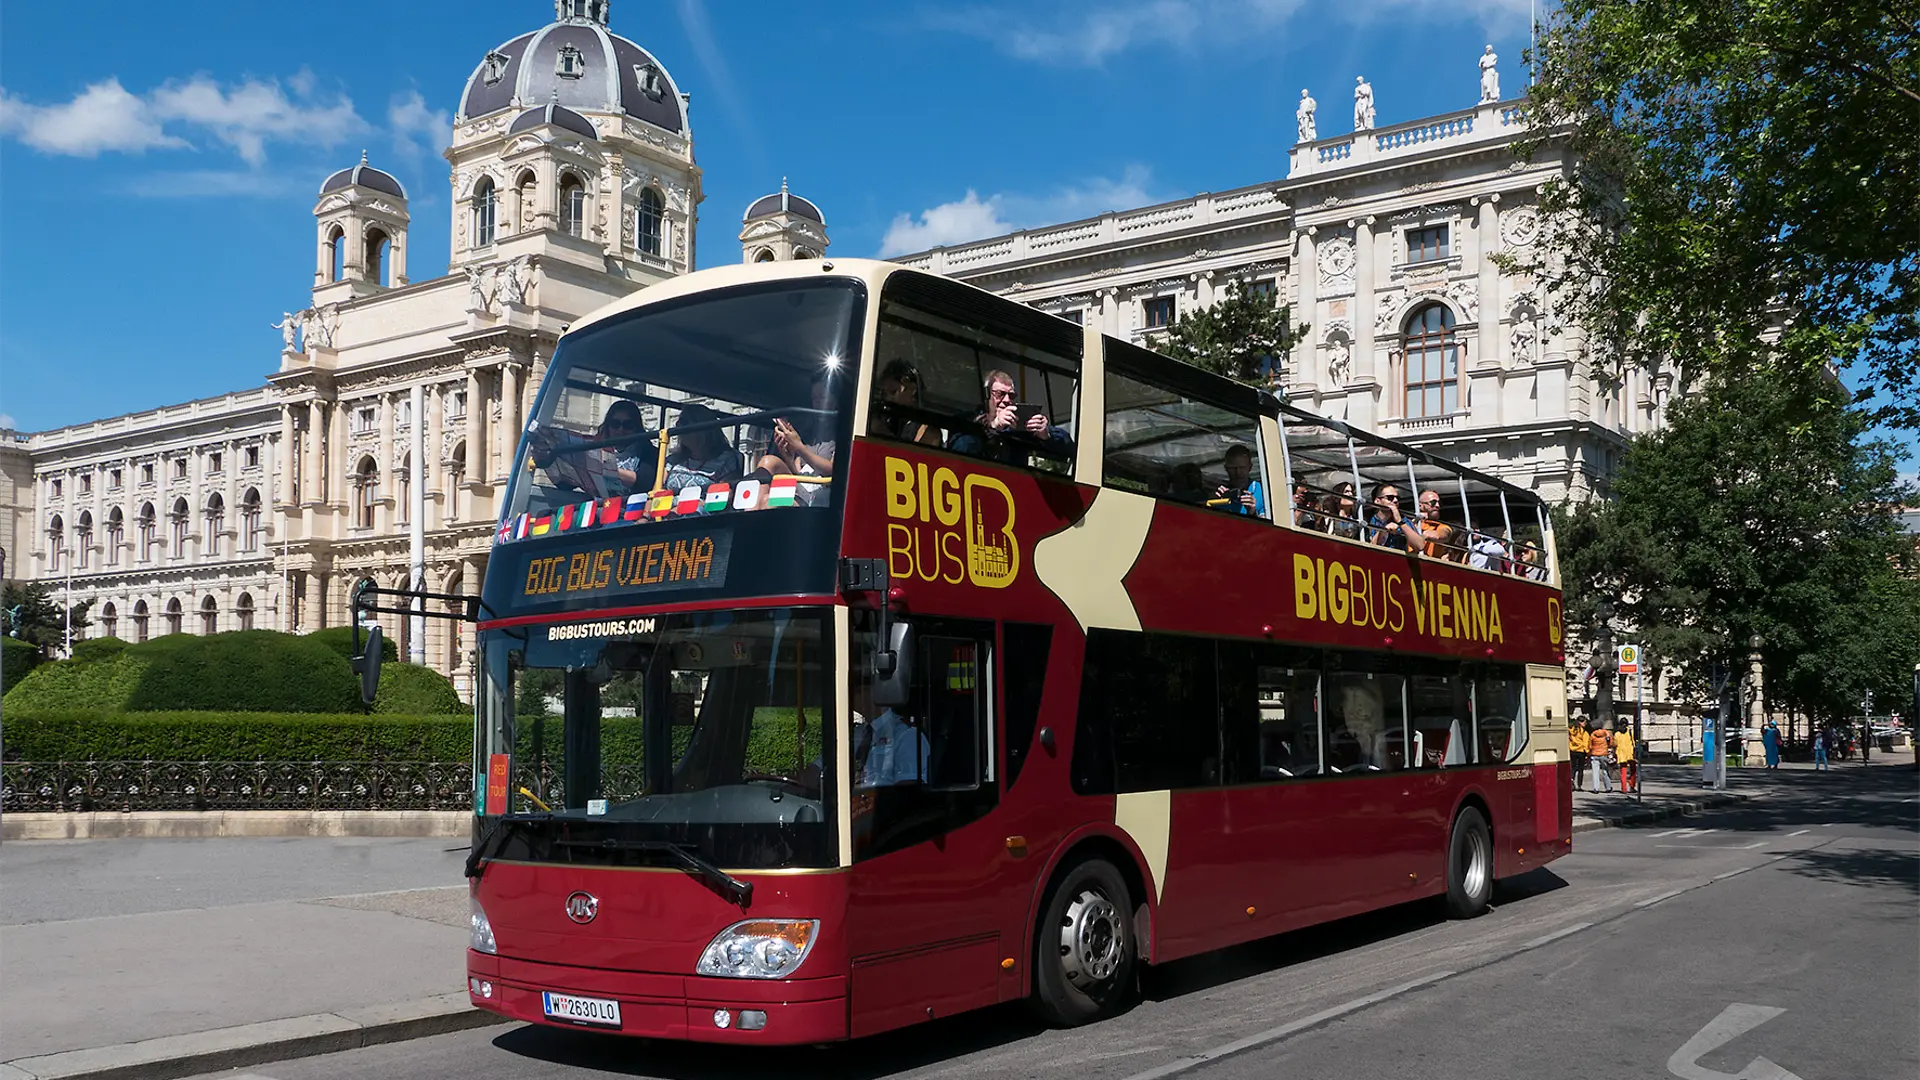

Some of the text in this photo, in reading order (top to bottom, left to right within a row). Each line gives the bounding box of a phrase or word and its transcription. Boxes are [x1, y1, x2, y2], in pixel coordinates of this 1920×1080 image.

[885, 456, 961, 526] BIG
[524, 536, 714, 595] BIG BUS VIENNA
[888, 523, 965, 584] BUS
[548, 618, 656, 641] BIGBUSTOURS.COM
[1410, 577, 1503, 643] VIENNA
[493, 764, 506, 776] RED
[489, 785, 506, 797] TOUR
[551, 996, 560, 1013] W
[568, 999, 597, 1018] 2630
